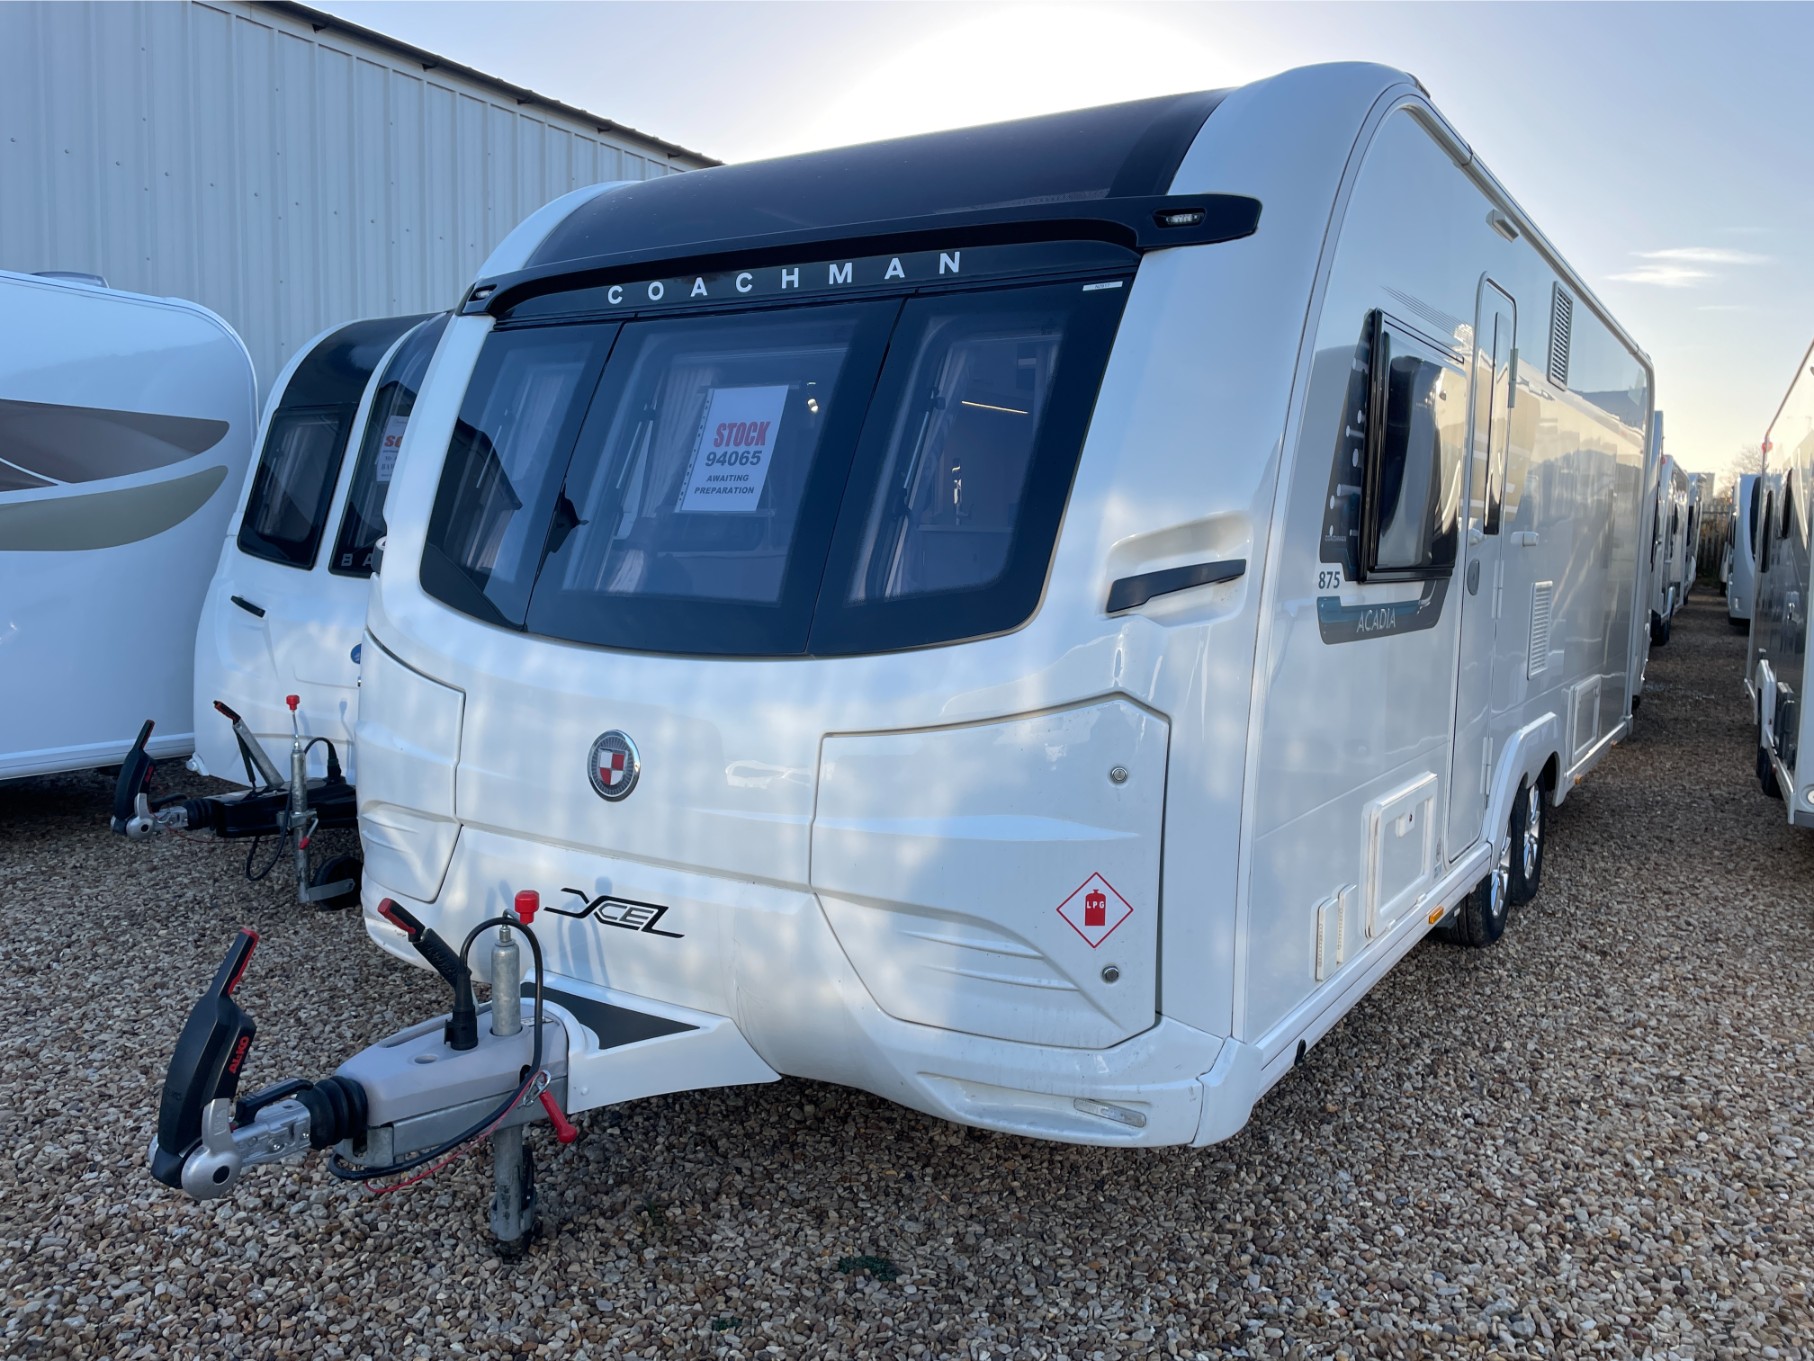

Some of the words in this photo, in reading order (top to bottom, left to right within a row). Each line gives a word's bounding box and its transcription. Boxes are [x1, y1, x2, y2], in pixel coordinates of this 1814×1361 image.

[607, 251, 961, 305] COACHMAN
[713, 421, 771, 447] STOCK
[705, 450, 762, 467] 94065
[706, 474, 749, 482] AWAITING
[694, 486, 754, 495] PREPARATION
[1318, 571, 1341, 589] 875
[1356, 607, 1396, 633] ACADIA
[1086, 901, 1105, 909] LPG
